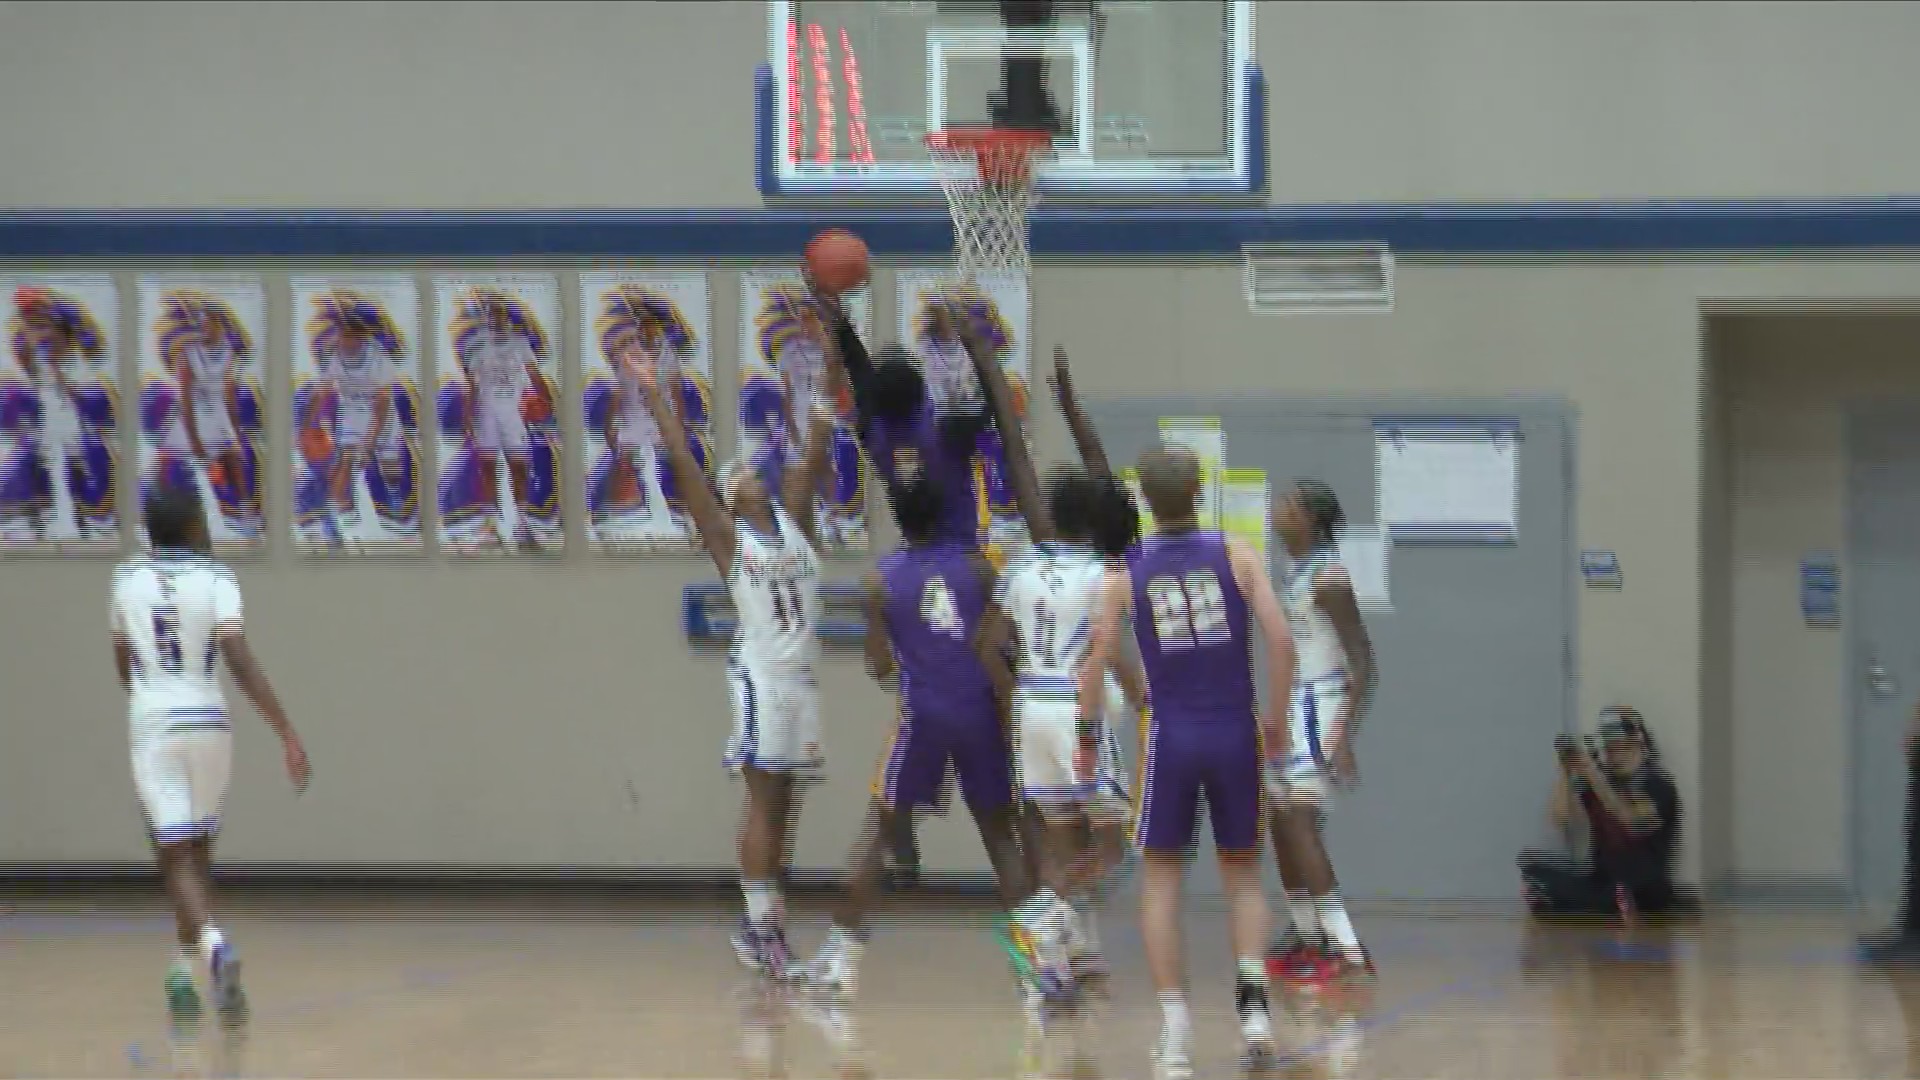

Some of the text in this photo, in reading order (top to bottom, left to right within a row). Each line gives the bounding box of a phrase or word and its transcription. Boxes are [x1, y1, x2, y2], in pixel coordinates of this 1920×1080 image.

[151, 604, 184, 674] 5
[920, 575, 965, 641] 4
[1147, 568, 1232, 654] 22
